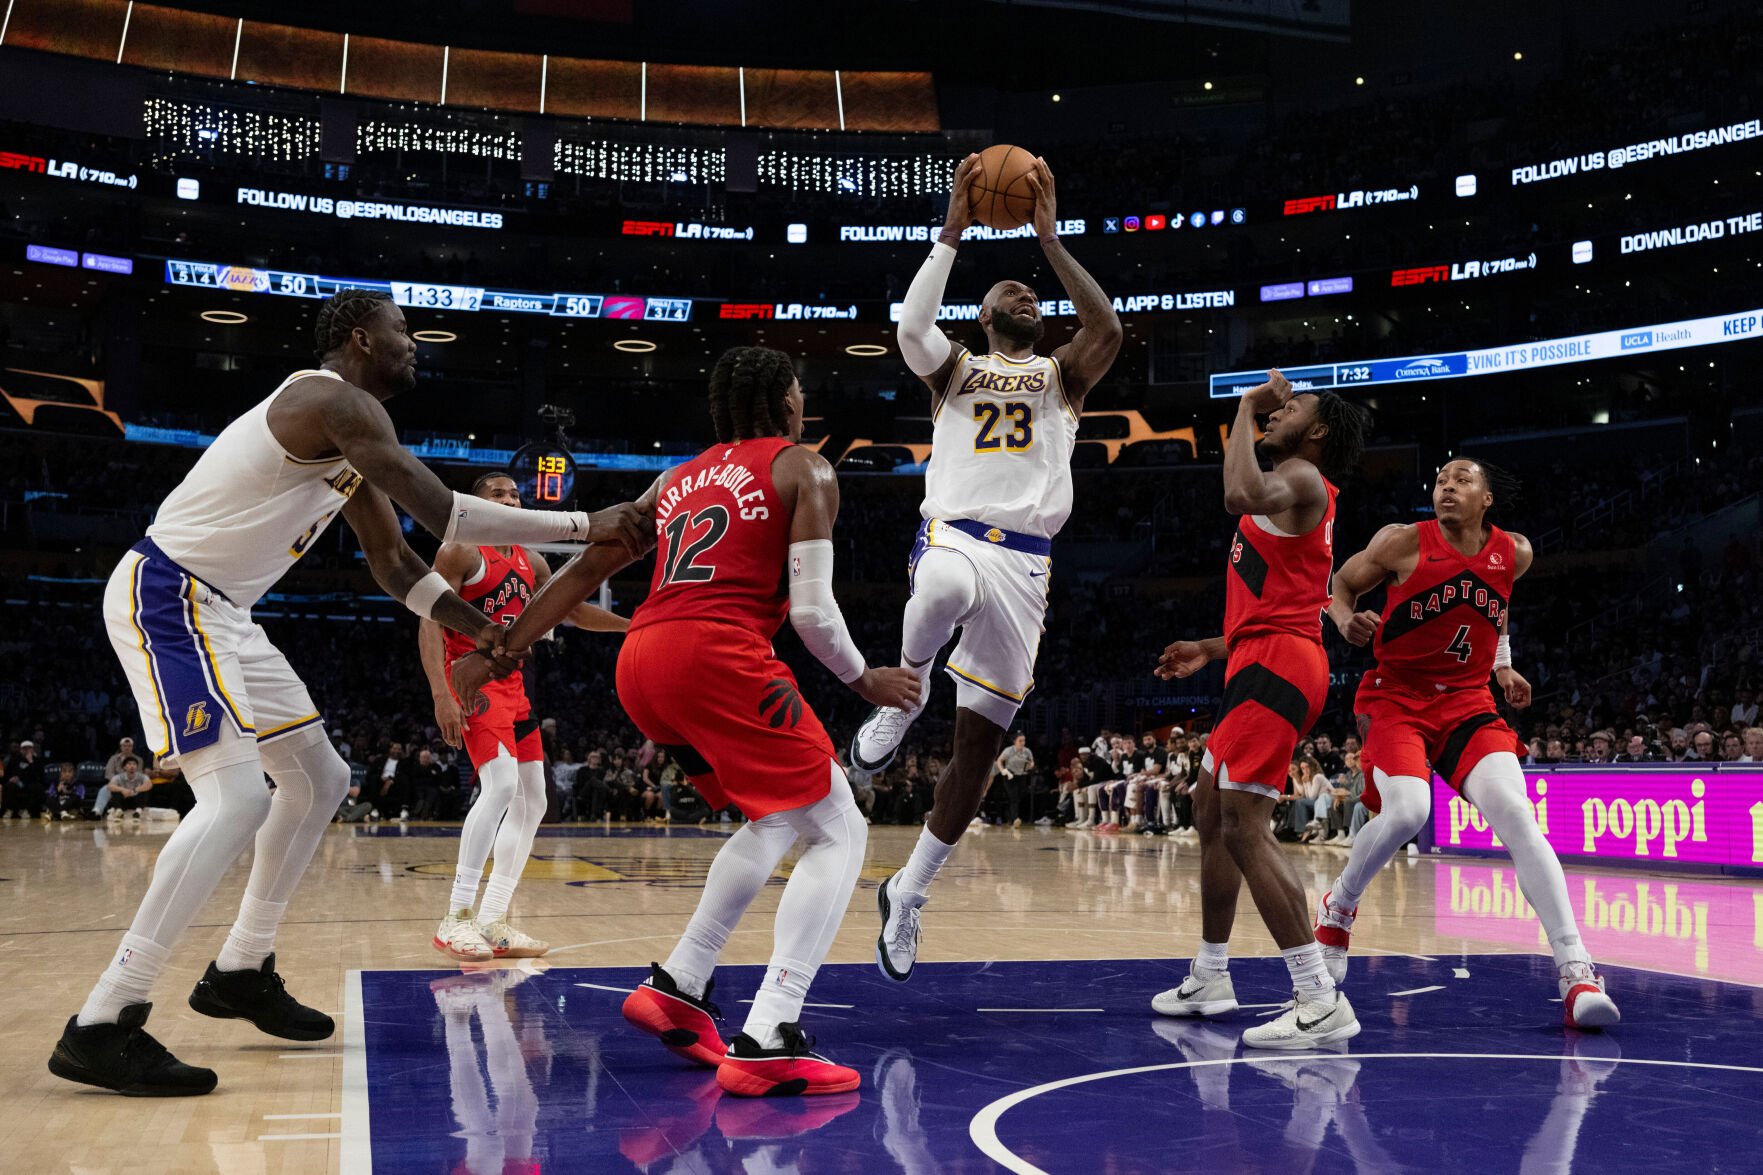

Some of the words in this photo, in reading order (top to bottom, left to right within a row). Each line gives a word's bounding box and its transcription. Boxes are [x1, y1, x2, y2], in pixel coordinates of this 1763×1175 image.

[0, 152, 45, 173] SPN
[48, 160, 78, 178] LA
[1512, 157, 1578, 185] FOLLOW
[1581, 152, 1604, 171] US
[238, 188, 307, 210] FOLLOW
[310, 197, 334, 214] US
[336, 200, 504, 229] @ESPNLOSANGELES
[1284, 195, 1335, 216] ESPN
[1337, 191, 1364, 209] LA
[622, 220, 674, 237] ESPN
[675, 223, 702, 239] LA
[841, 226, 903, 241] FOLLOW
[906, 226, 929, 241] US
[1621, 221, 1724, 254] DOWNLOAD
[1727, 212, 1762, 235] THE
[179, 271, 188, 282] 5
[200, 273, 210, 284] 4
[1392, 265, 1449, 287] ESPN
[1452, 260, 1480, 281] LA
[281, 275, 306, 294] 50
[404, 286, 453, 307] 1:33
[469, 297, 477, 309] 2
[493, 296, 542, 310] Raptors
[566, 298, 590, 315] 50
[1126, 296, 1159, 312] APP
[1162, 295, 1174, 310] &
[1177, 290, 1235, 309] LISTEN
[654, 307, 663, 318] 3
[674, 308, 684, 319] 4
[720, 303, 773, 319] ESPN
[775, 304, 802, 320] LA
[1723, 315, 1756, 336] KEEP
[1624, 335, 1649, 346] UCLA
[1656, 328, 1692, 343] Health
[1531, 339, 1591, 362] POSSIBLE
[957, 367, 1046, 396] LAKERS
[1341, 367, 1370, 382] 7:32
[973, 401, 1034, 454] 23
[538, 456, 566, 473] 1:33
[537, 473, 562, 501] 10
[657, 504, 731, 591] 12
[1411, 580, 1506, 627] RAPTORS
[1444, 624, 1472, 664] 4
[1449, 778, 1549, 846] poi
[1581, 778, 1708, 857] poppi
